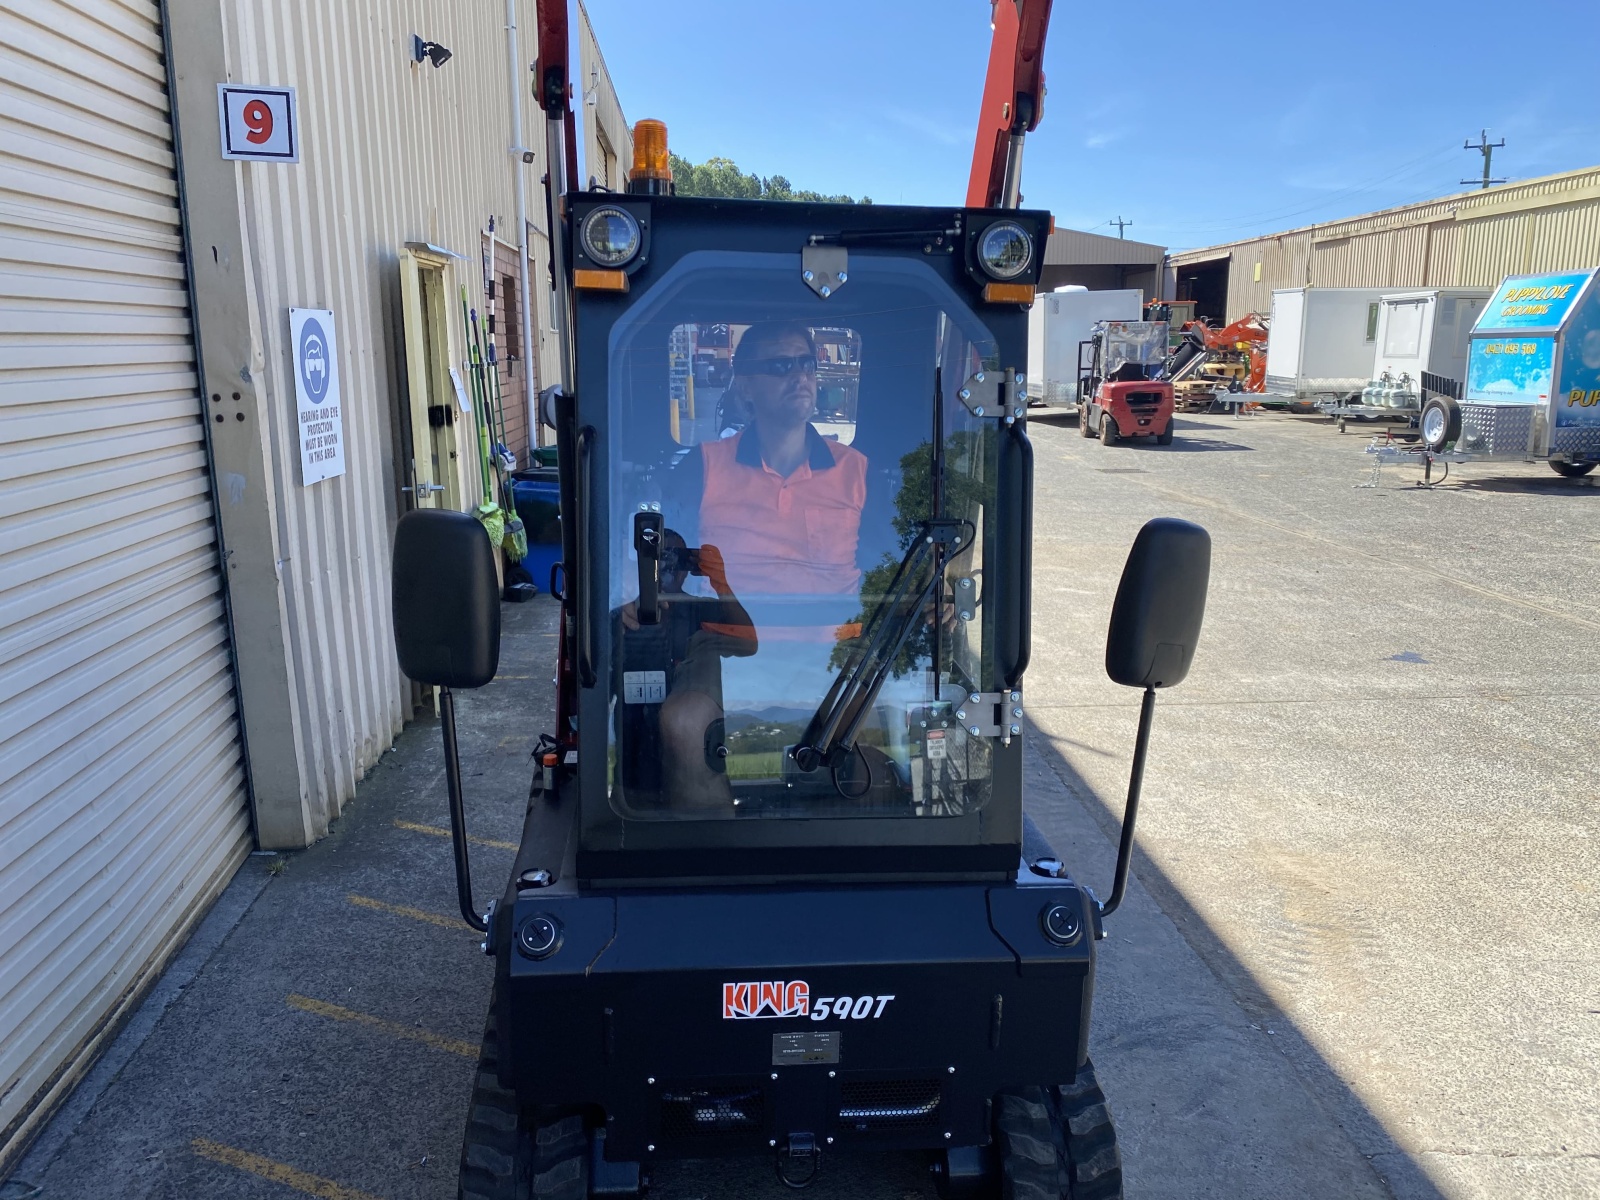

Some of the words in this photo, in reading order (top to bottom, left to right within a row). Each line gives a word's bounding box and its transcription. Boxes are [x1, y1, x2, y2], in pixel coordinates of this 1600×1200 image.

[243, 99, 273, 145] 9
[1501, 284, 1574, 303] PUPPYLOVE
[1501, 303, 1553, 317] GROOMING
[300, 409, 319, 424] HEARING
[320, 407, 329, 420] AND
[330, 406, 338, 418] EYE
[307, 420, 333, 436] PROTECTION
[305, 438, 316, 451] MUST
[317, 436, 323, 448] BE
[323, 433, 338, 446] WORN
[309, 452, 315, 464] IN
[314, 450, 323, 463] THIS
[324, 447, 336, 460] AREA
[723, 980, 809, 1019] KING
[810, 995, 895, 1021] 590T
